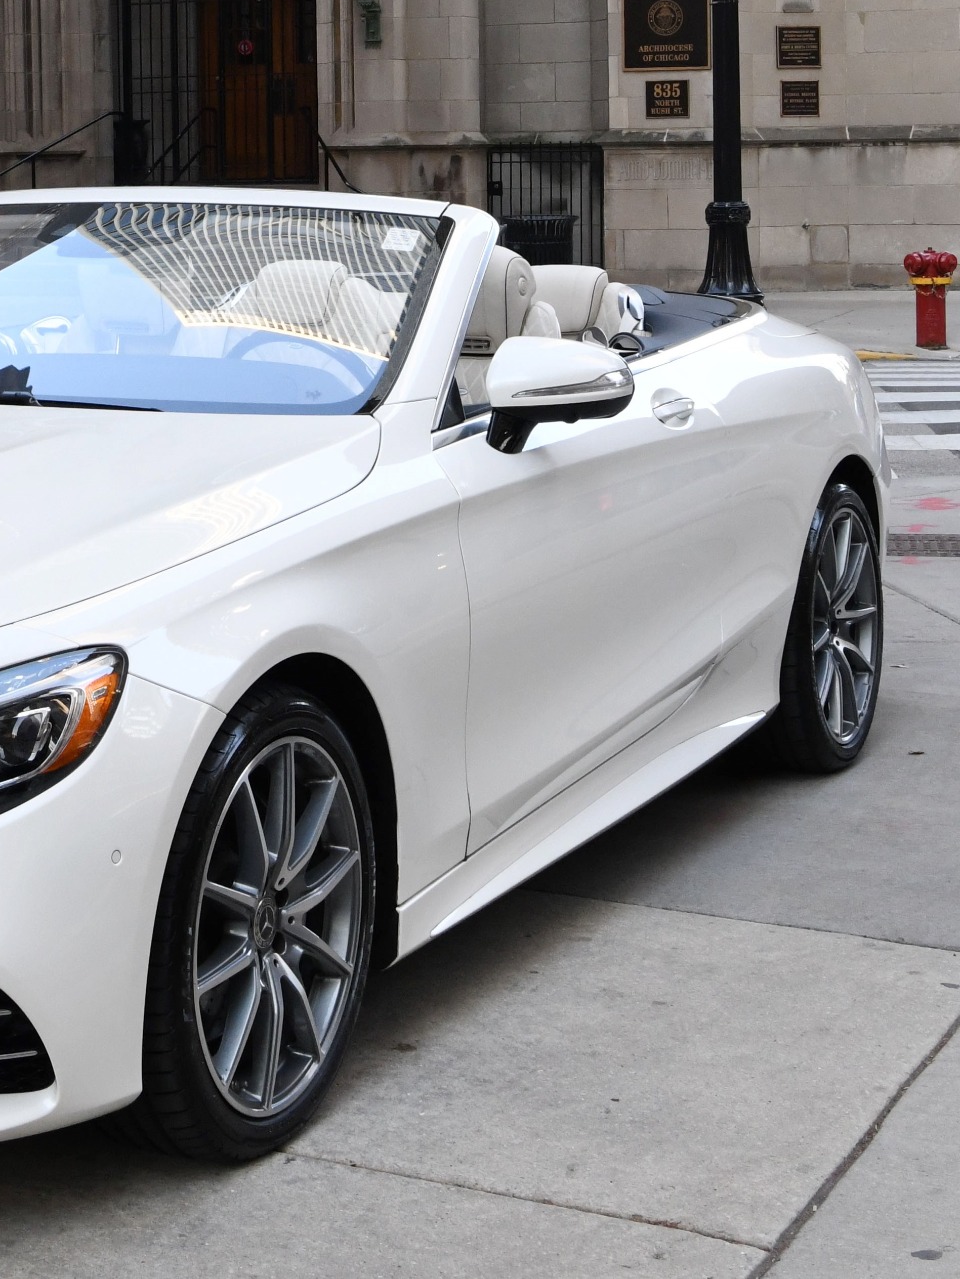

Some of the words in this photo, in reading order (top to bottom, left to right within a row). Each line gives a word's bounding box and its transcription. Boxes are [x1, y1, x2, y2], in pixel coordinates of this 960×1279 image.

[638, 43, 694, 53] ARCHDIOCESE
[642, 54, 654, 62] OF
[654, 53, 690, 62] CHICAGO
[653, 82, 681, 98] 835
[654, 99, 680, 107] NORTH
